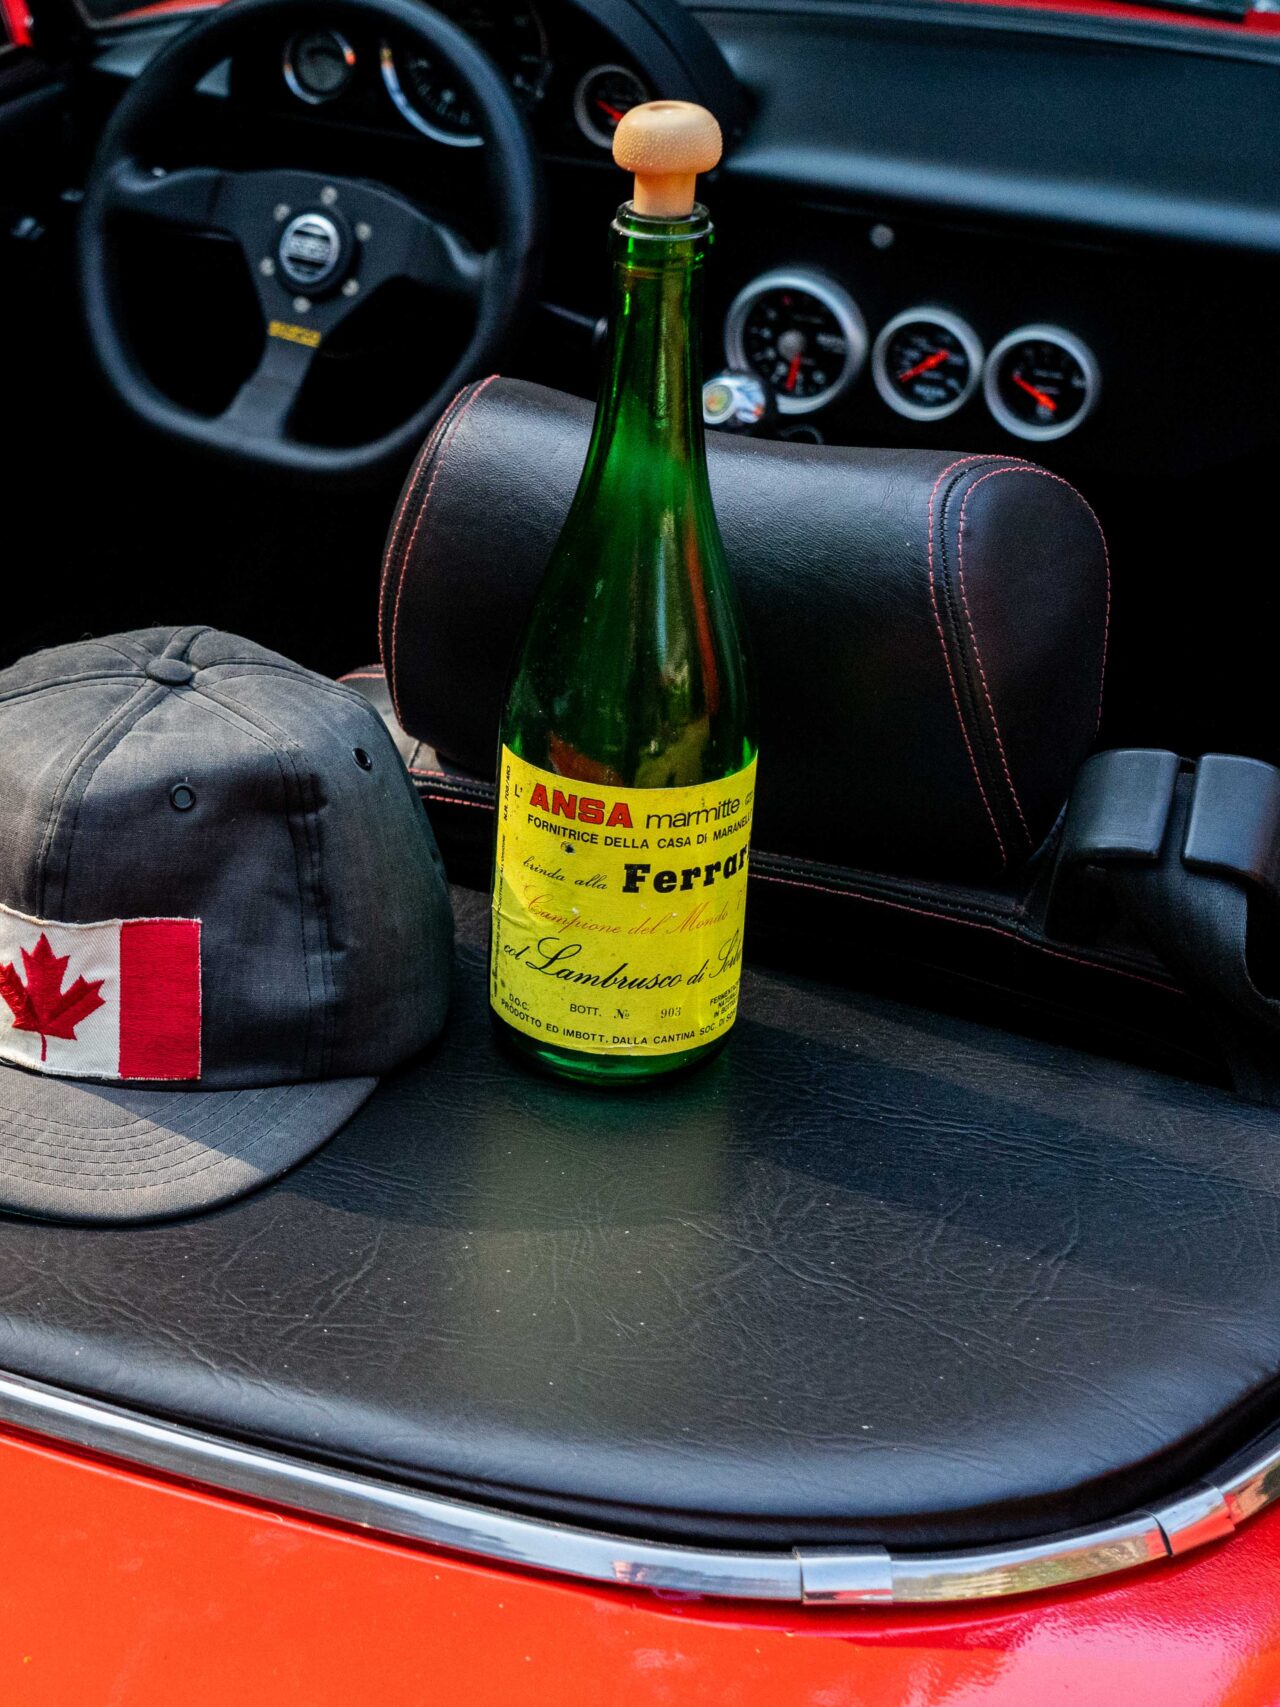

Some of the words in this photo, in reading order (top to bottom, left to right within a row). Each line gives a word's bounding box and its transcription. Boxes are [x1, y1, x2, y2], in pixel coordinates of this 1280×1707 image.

[529, 783, 633, 828] ANSA
[646, 798, 740, 828] marmitte
[528, 814, 598, 844] FORNITRICE
[604, 836, 649, 849] DELLA
[658, 835, 691, 848] CASA
[697, 833, 707, 843] DI
[523, 856, 567, 881] brinda
[574, 873, 607, 890] alla
[622, 844, 748, 893] Ferrar
[524, 884, 621, 934] Campione
[628, 915, 664, 935] del
[666, 899, 729, 934] Mondo
[503, 943, 530, 961] col
[526, 937, 682, 990] Lambrusco
[687, 959, 711, 985] di
[501, 998, 542, 1028] PRODOTTO
[546, 1023, 559, 1034] ED
[563, 1028, 608, 1044] IMBOTT.
[613, 1035, 648, 1045] DALLA
[653, 1030, 696, 1045] CANTINA
[700, 1021, 718, 1035] SOC.
[719, 1018, 727, 1028] DI
[570, 1003, 602, 1017] BOTT.
[660, 1007, 682, 1019] 903
